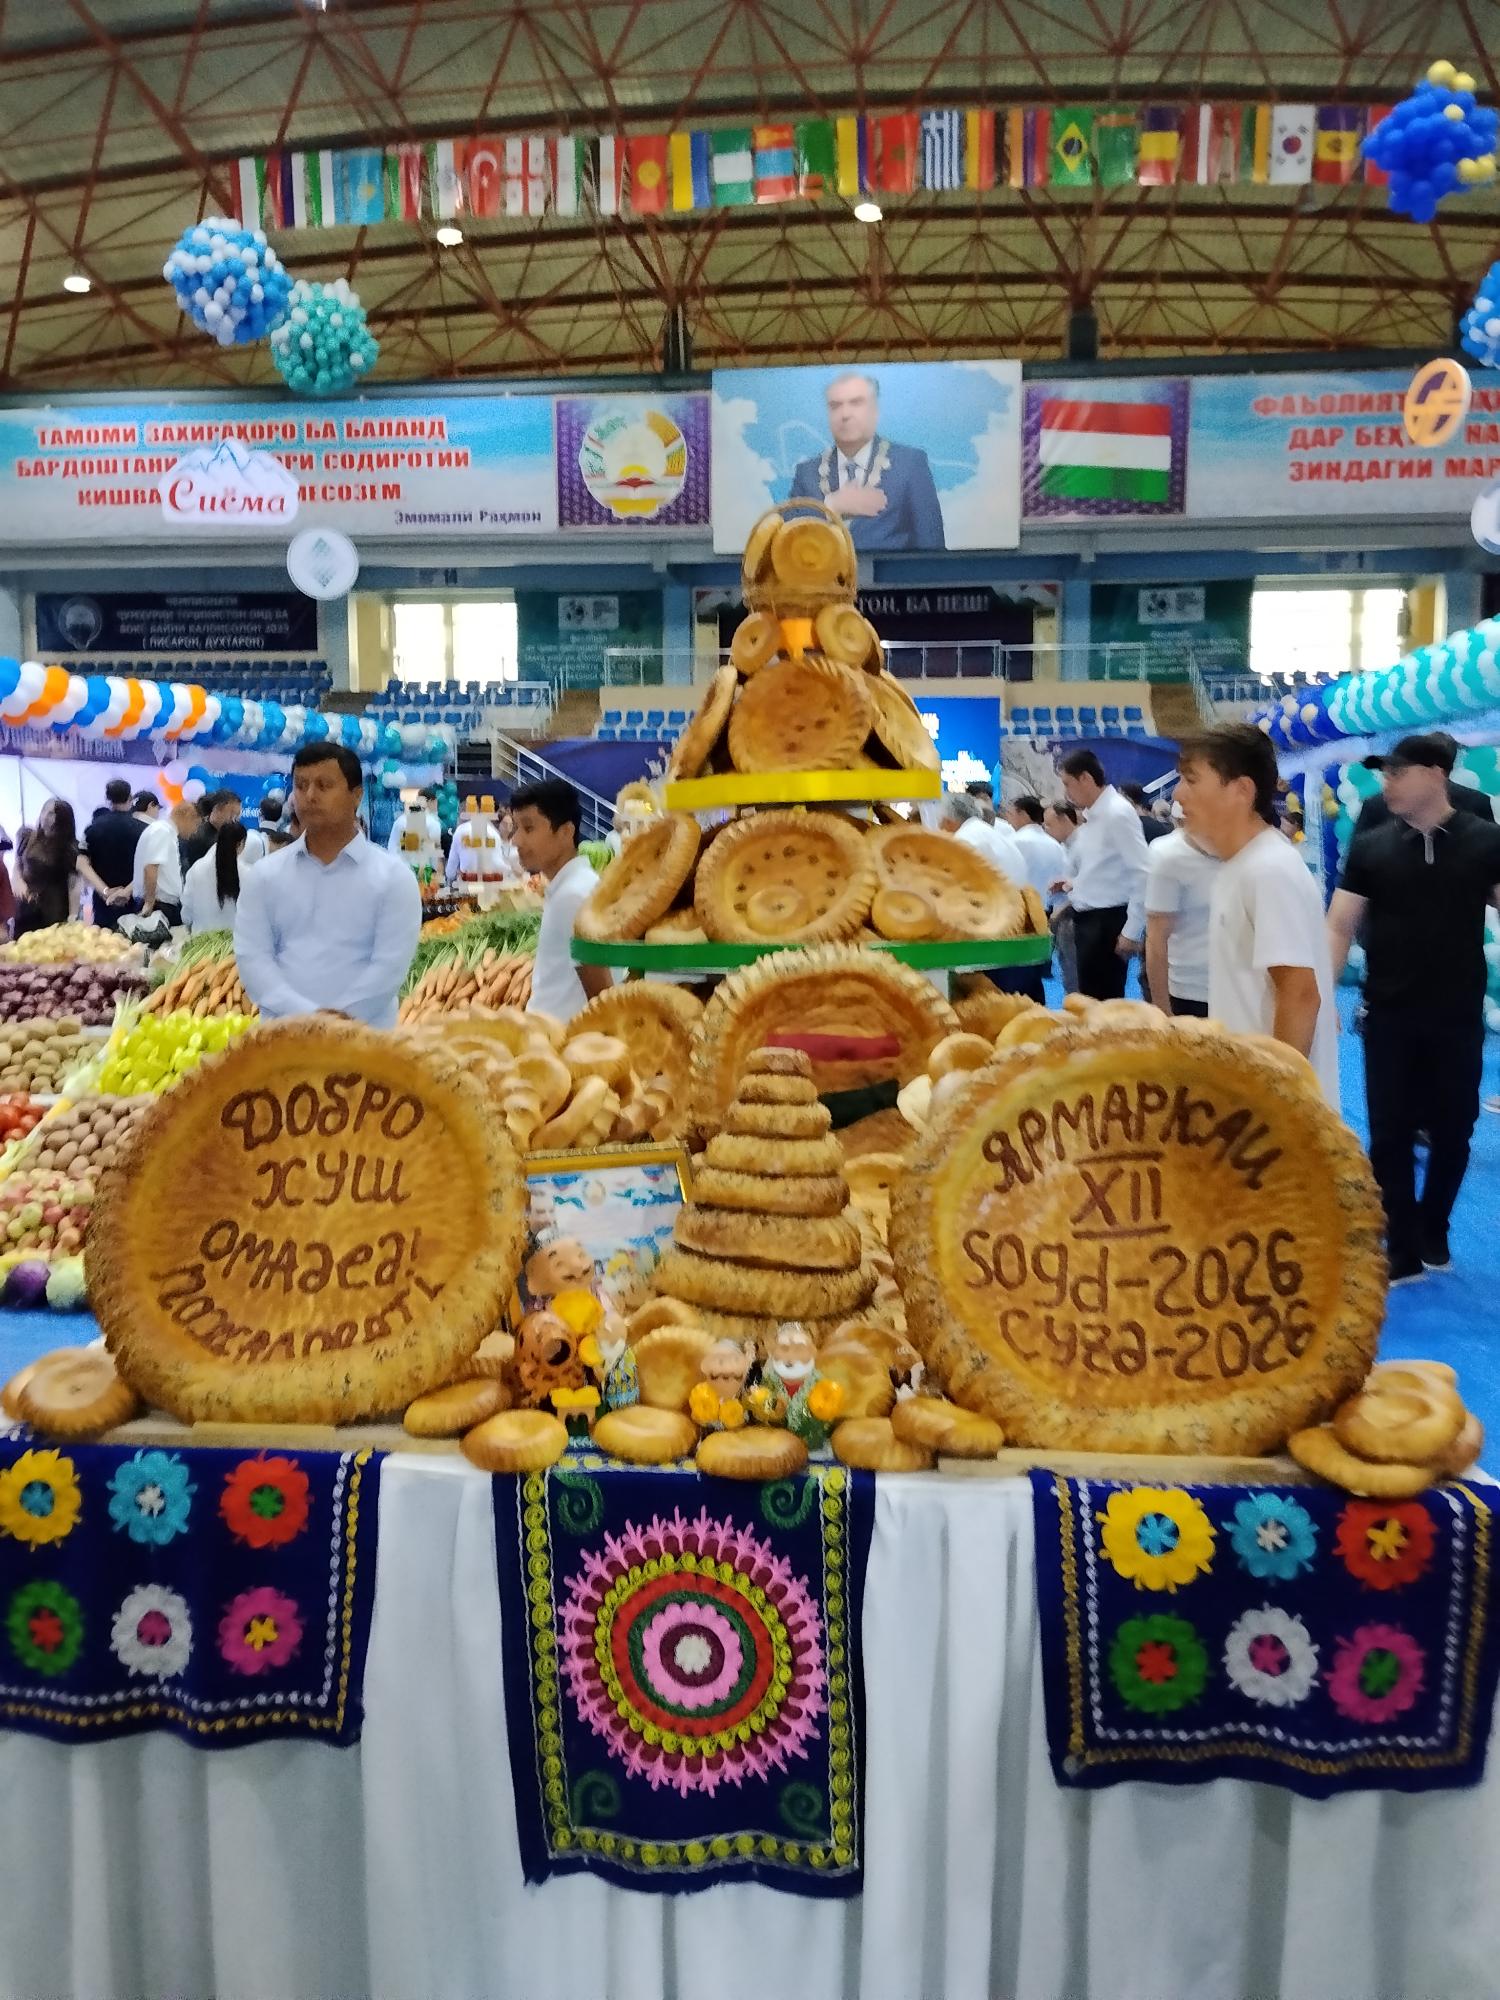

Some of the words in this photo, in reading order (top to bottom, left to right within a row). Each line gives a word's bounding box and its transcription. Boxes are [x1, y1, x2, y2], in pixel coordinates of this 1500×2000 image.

[38, 426, 137, 446] ТАМОМИ
[1288, 427, 1345, 451] ДАР
[1288, 459, 1433, 483] ЗИНДАГИИ
[78, 488, 162, 506] КИШВА
[251, 1149, 412, 1210] ХУШ
[1069, 1164, 1163, 1227] XII
